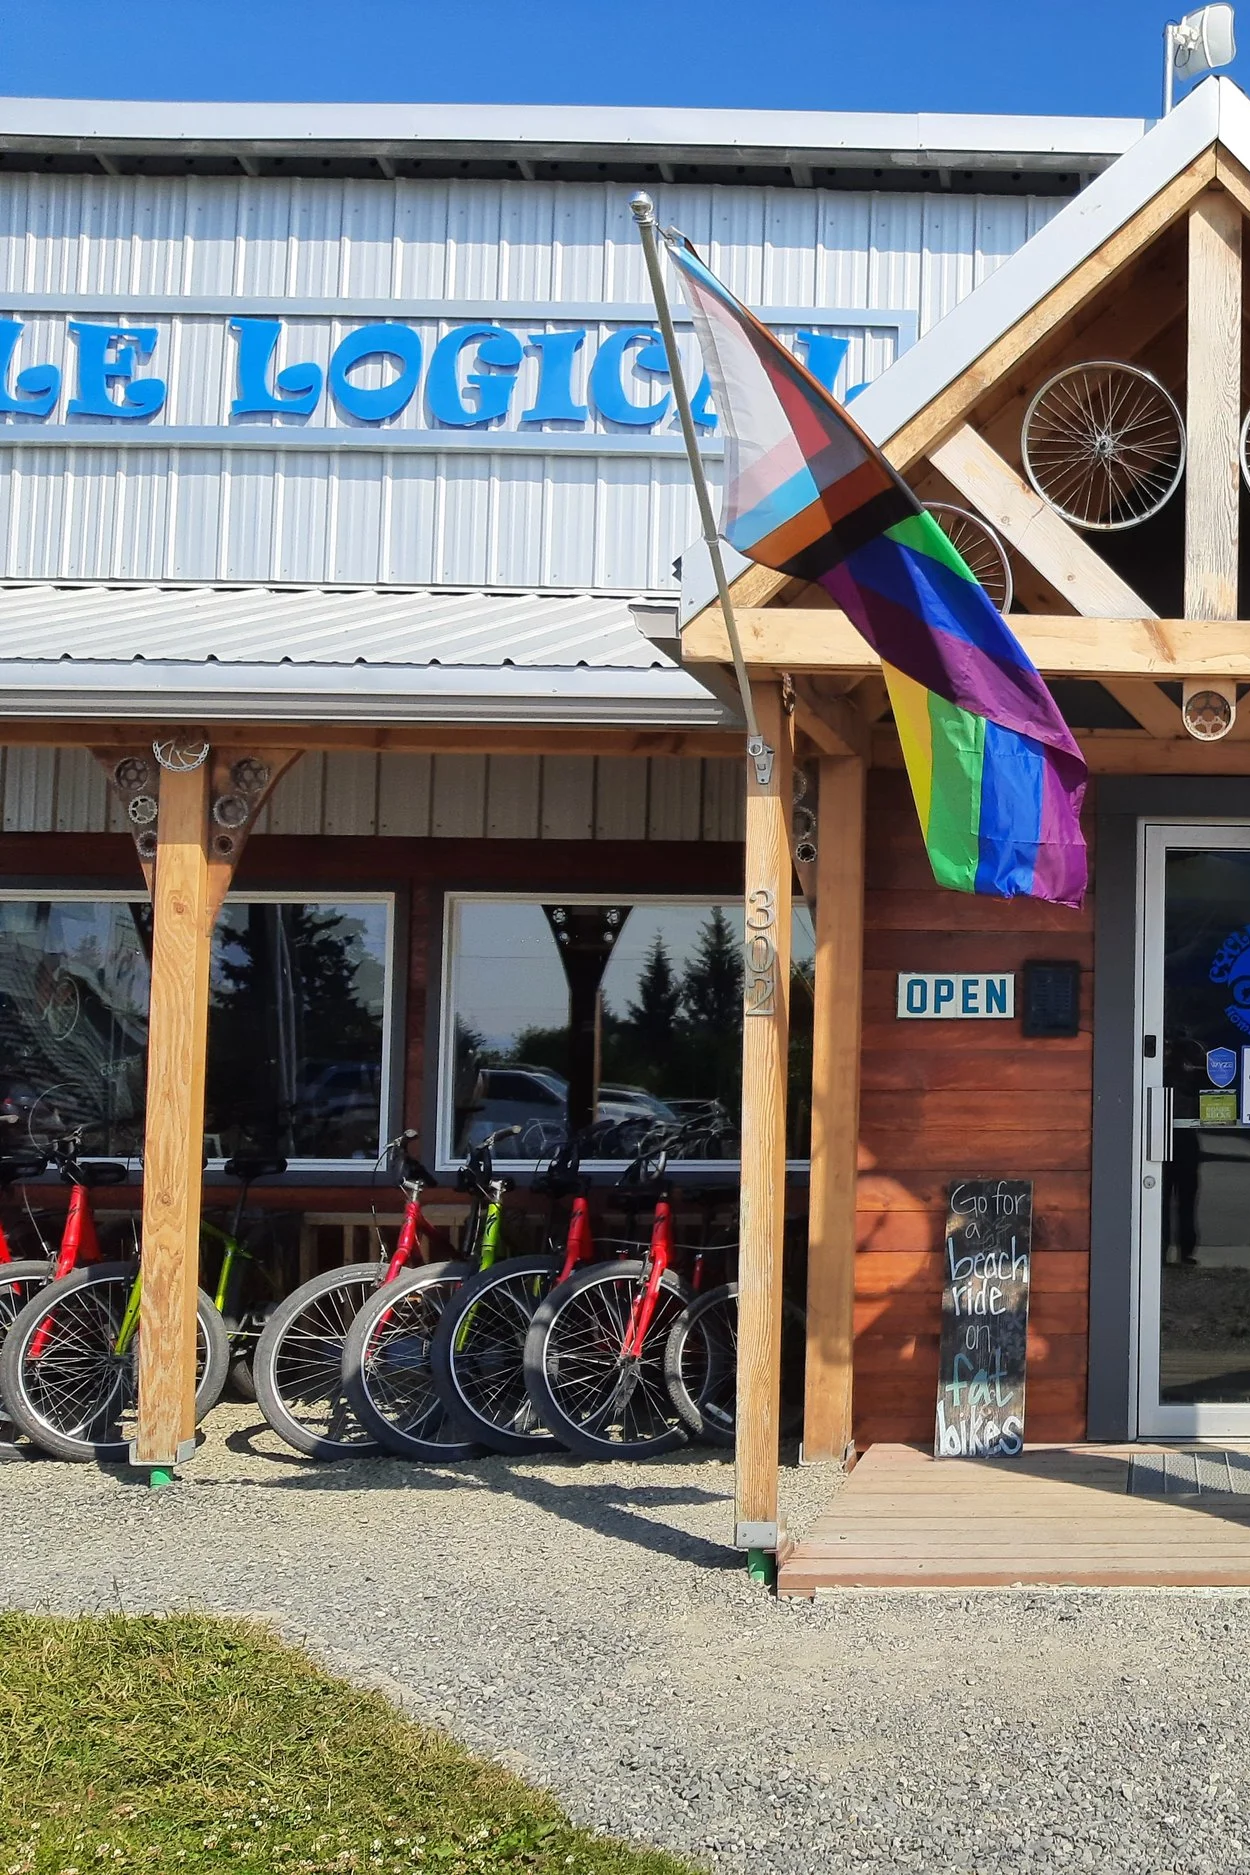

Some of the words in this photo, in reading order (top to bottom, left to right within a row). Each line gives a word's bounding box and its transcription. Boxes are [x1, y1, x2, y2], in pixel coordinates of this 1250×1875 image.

[229, 317, 871, 427] LOGICL
[744, 889, 776, 1016] 302
[906, 978, 1007, 1015] OPEN
[950, 1184, 988, 1215] Go
[992, 1180, 1026, 1215] for
[965, 1221, 981, 1239] a
[947, 1236, 1028, 1283] beach
[952, 1279, 1007, 1316] ride
[965, 1324, 991, 1351] on
[945, 1348, 1014, 1409] fat
[936, 1400, 1024, 1457] bikes
